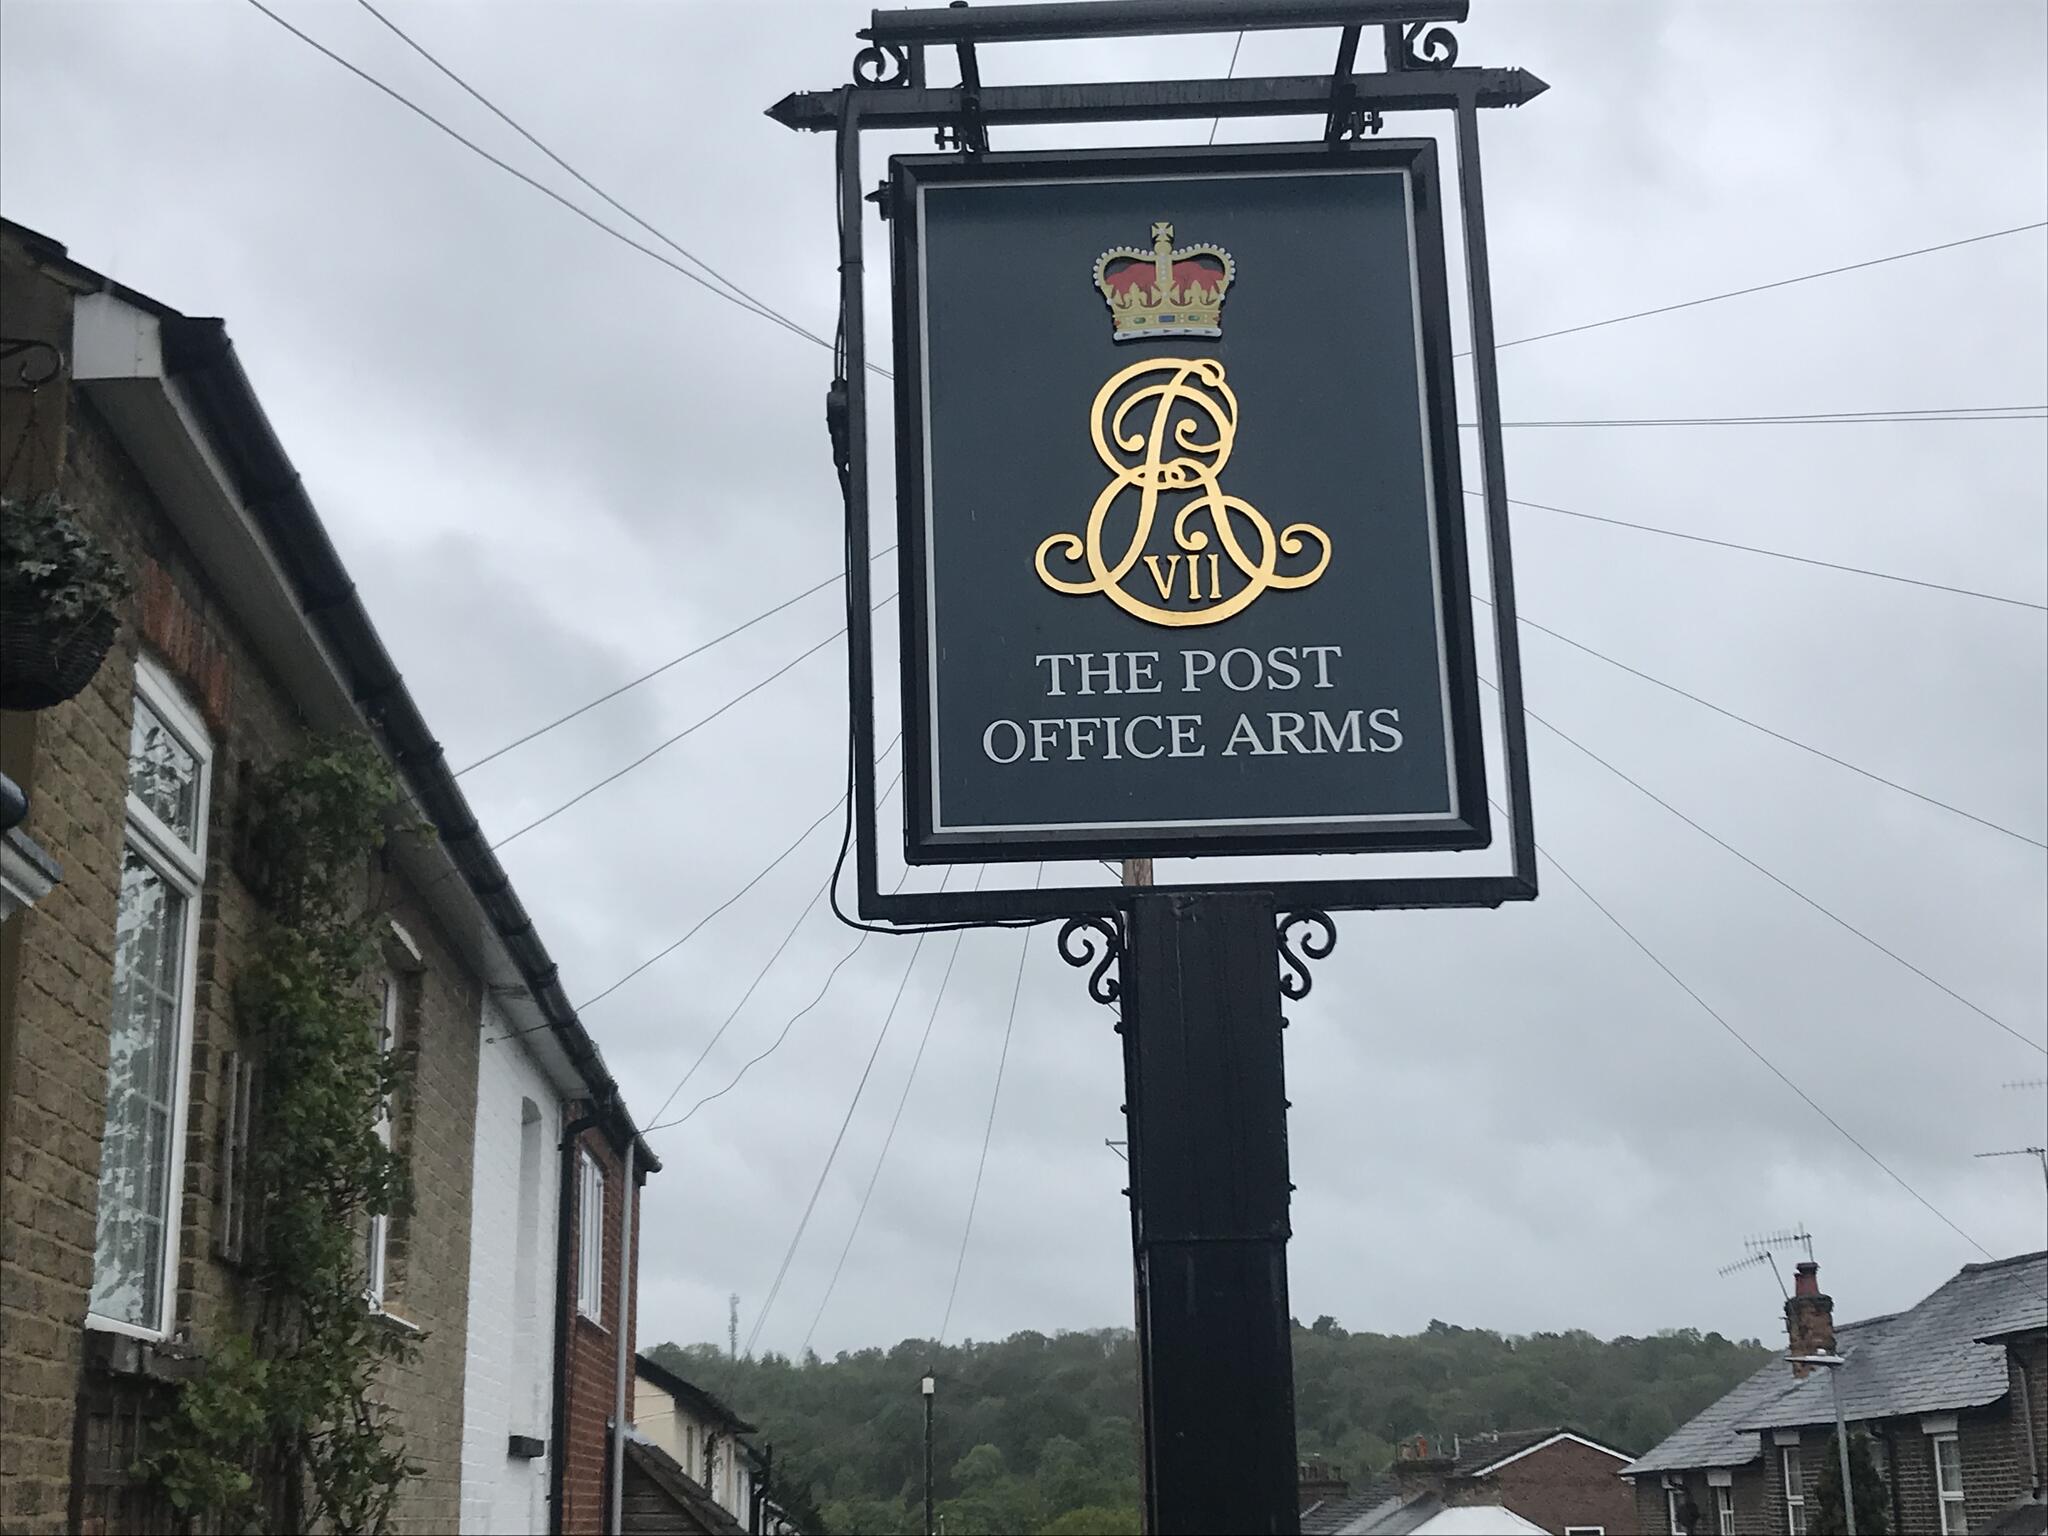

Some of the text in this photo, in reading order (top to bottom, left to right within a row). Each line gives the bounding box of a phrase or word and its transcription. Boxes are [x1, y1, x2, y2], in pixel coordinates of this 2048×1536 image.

[1142, 553, 1222, 600] VII
[1035, 645, 1343, 696] THE POST
[982, 708, 1404, 764] OFFICE ARMS
